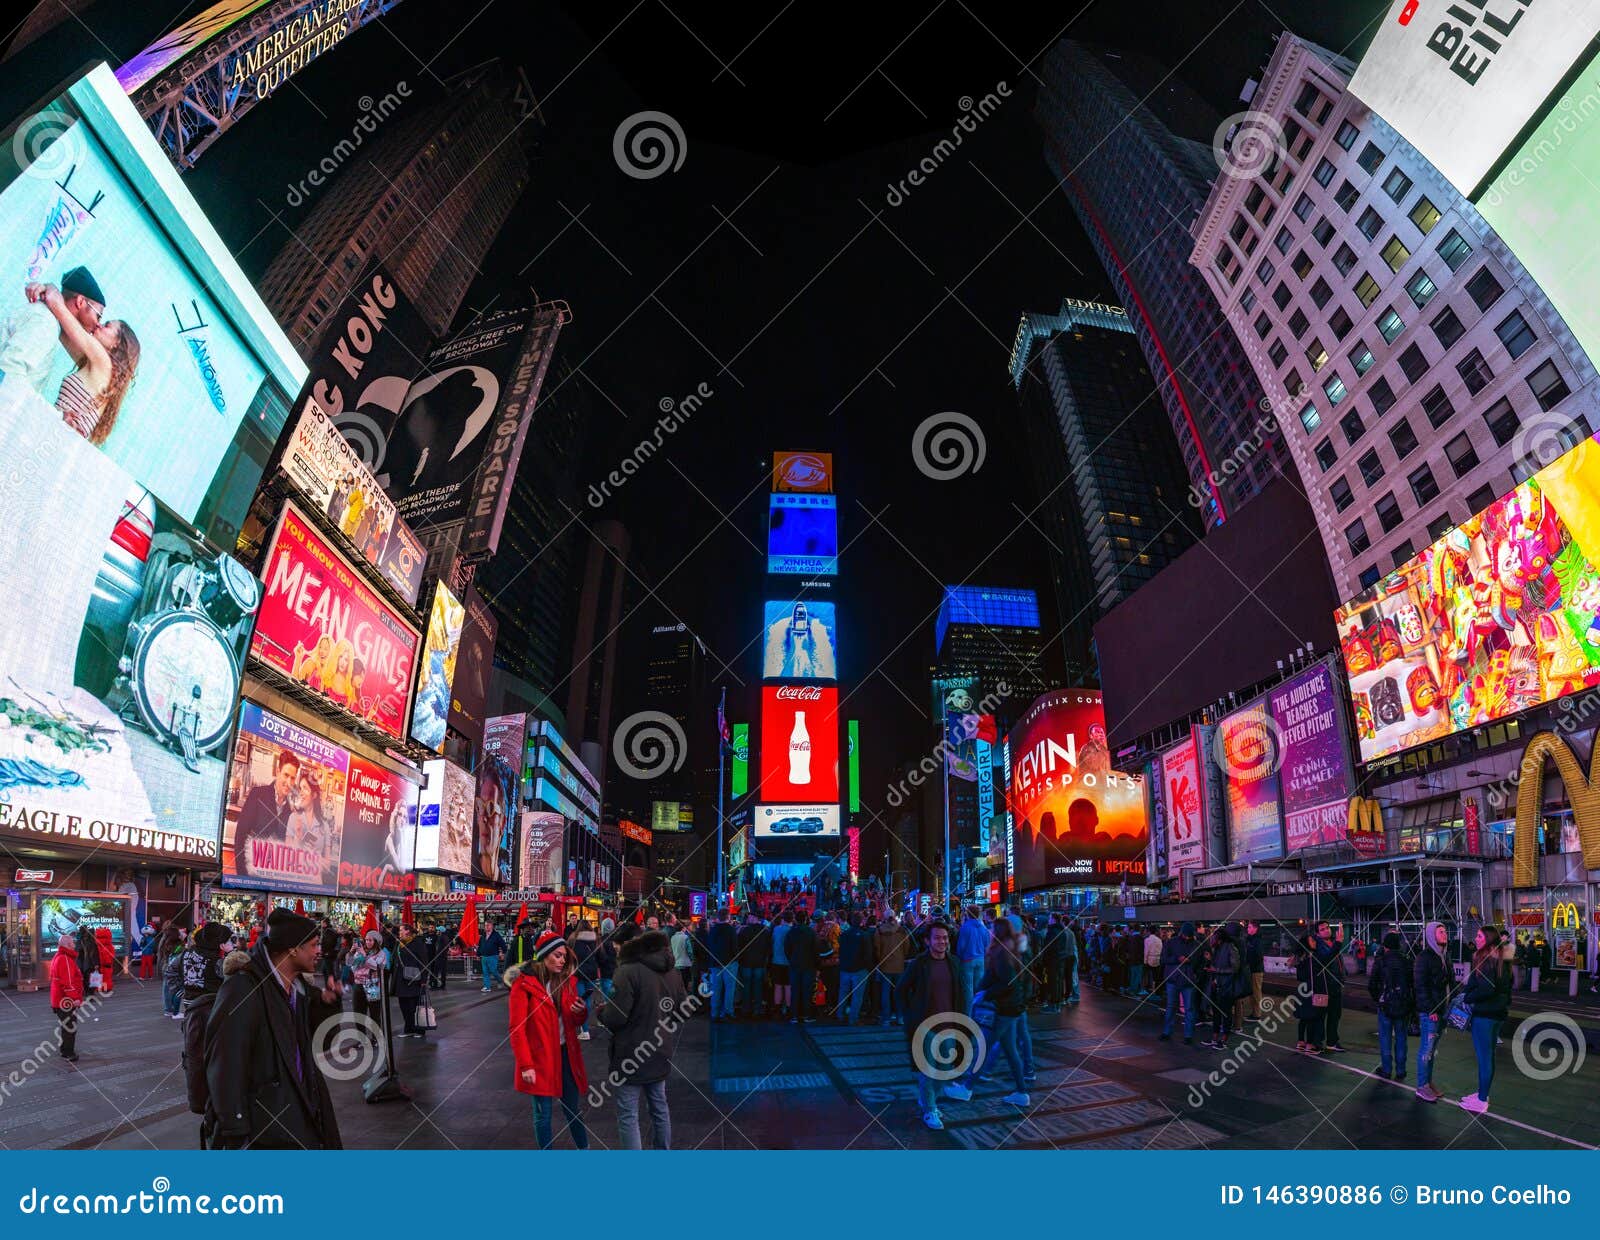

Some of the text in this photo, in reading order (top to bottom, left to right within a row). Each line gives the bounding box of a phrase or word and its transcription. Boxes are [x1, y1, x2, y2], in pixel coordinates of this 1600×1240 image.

[231, 5, 324, 88] AMERICAN
[257, 18, 347, 99] OUTFITTERS
[332, 275, 396, 380] KONG
[480, 329, 504, 341] FREE
[507, 324, 524, 334] ON
[445, 338, 501, 360] BROADWAY
[311, 405, 325, 424] SO
[328, 423, 359, 467] WRONG
[373, 487, 395, 515] RIGHT
[475, 403, 521, 517] SQUARE
[426, 483, 461, 497] THEATRE
[284, 518, 304, 542] YOU
[307, 536, 334, 569] KNOW
[336, 567, 353, 588] YOU
[354, 587, 381, 616] WANNA
[381, 613, 393, 627] SIT
[391, 622, 406, 642] WITH
[991, 593, 1032, 603] BARCLAYS
[268, 551, 409, 693] MEAN GIRLS
[653, 625, 676, 633] Allianz
[1290, 674, 1326, 706] AUDIENCE
[1286, 697, 1319, 726] REACHES
[260, 717, 287, 736] JOEY
[1284, 720, 1307, 746] FEVER
[485, 741, 501, 750] 0.89
[1014, 733, 1077, 794] KEVIN
[1293, 757, 1328, 777] DONNA
[352, 768, 392, 795] IT WOULD BE
[350, 787, 391, 812] CRIMINAL TO
[359, 807, 375, 823] MISS
[1287, 803, 1348, 837] JERSEY BOYS
[0, 803, 217, 857] EAGLE OUTFITTERS
[253, 840, 319, 876] WAITRESS
[1054, 860, 1144, 874] STREAMING NETFLIX
[1074, 859, 1092, 867] NOW
[339, 861, 416, 892] CHICAGO
[502, 890, 539, 900] HOTDOGS
